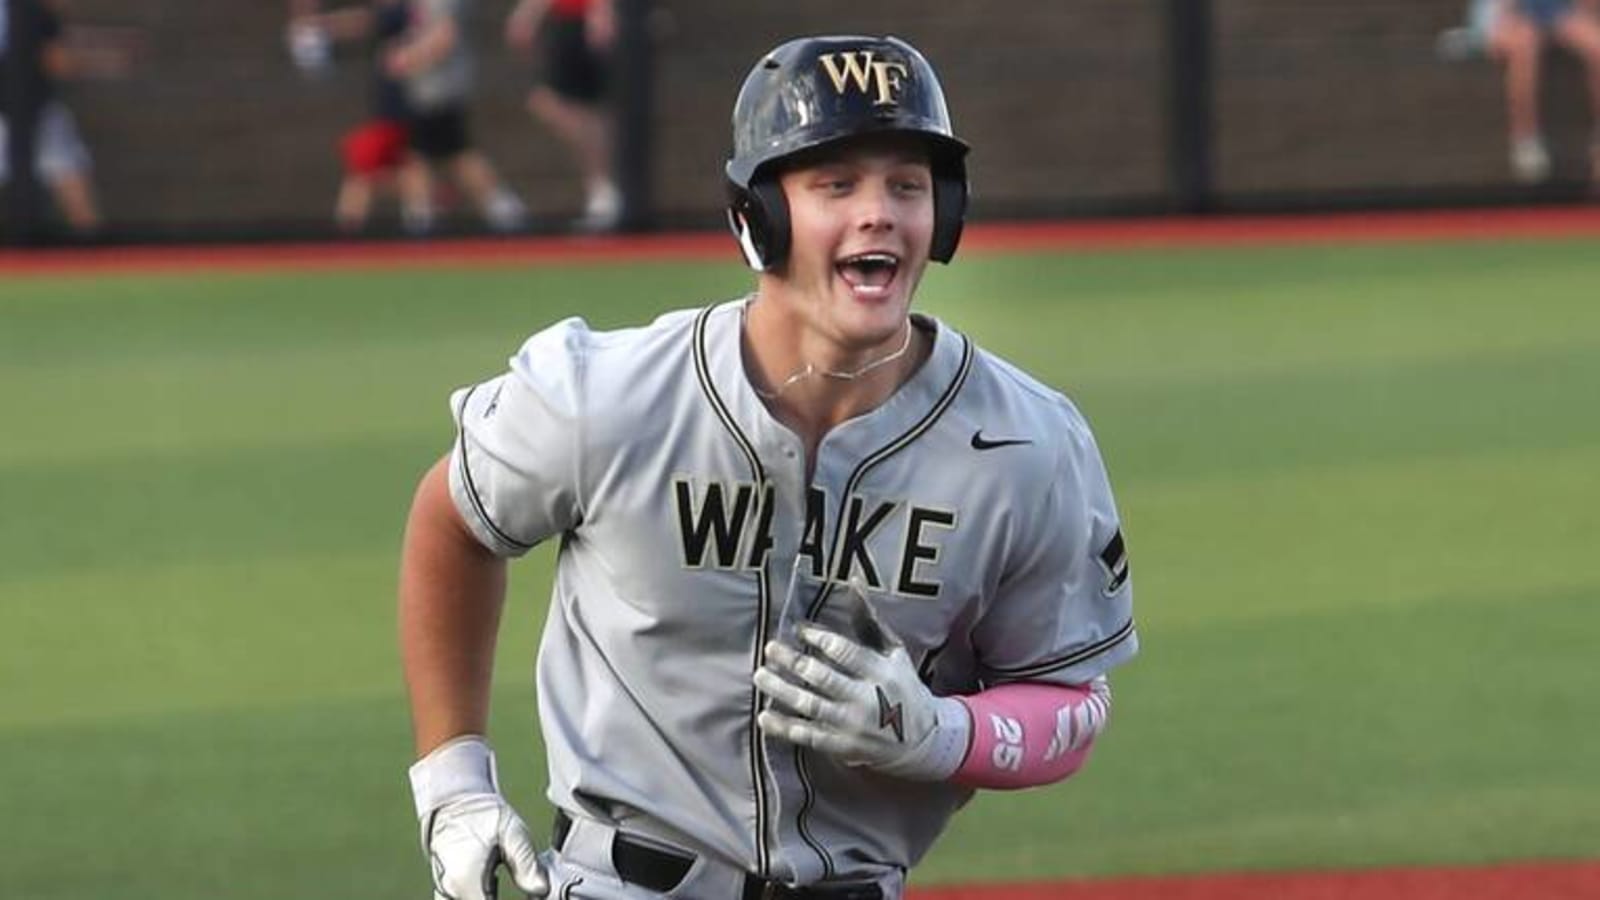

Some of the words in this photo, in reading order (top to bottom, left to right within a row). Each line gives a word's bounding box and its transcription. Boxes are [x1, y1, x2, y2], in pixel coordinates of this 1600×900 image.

[818, 51, 908, 106] WF
[673, 475, 957, 599] WAKE
[990, 713, 1025, 772] 25
